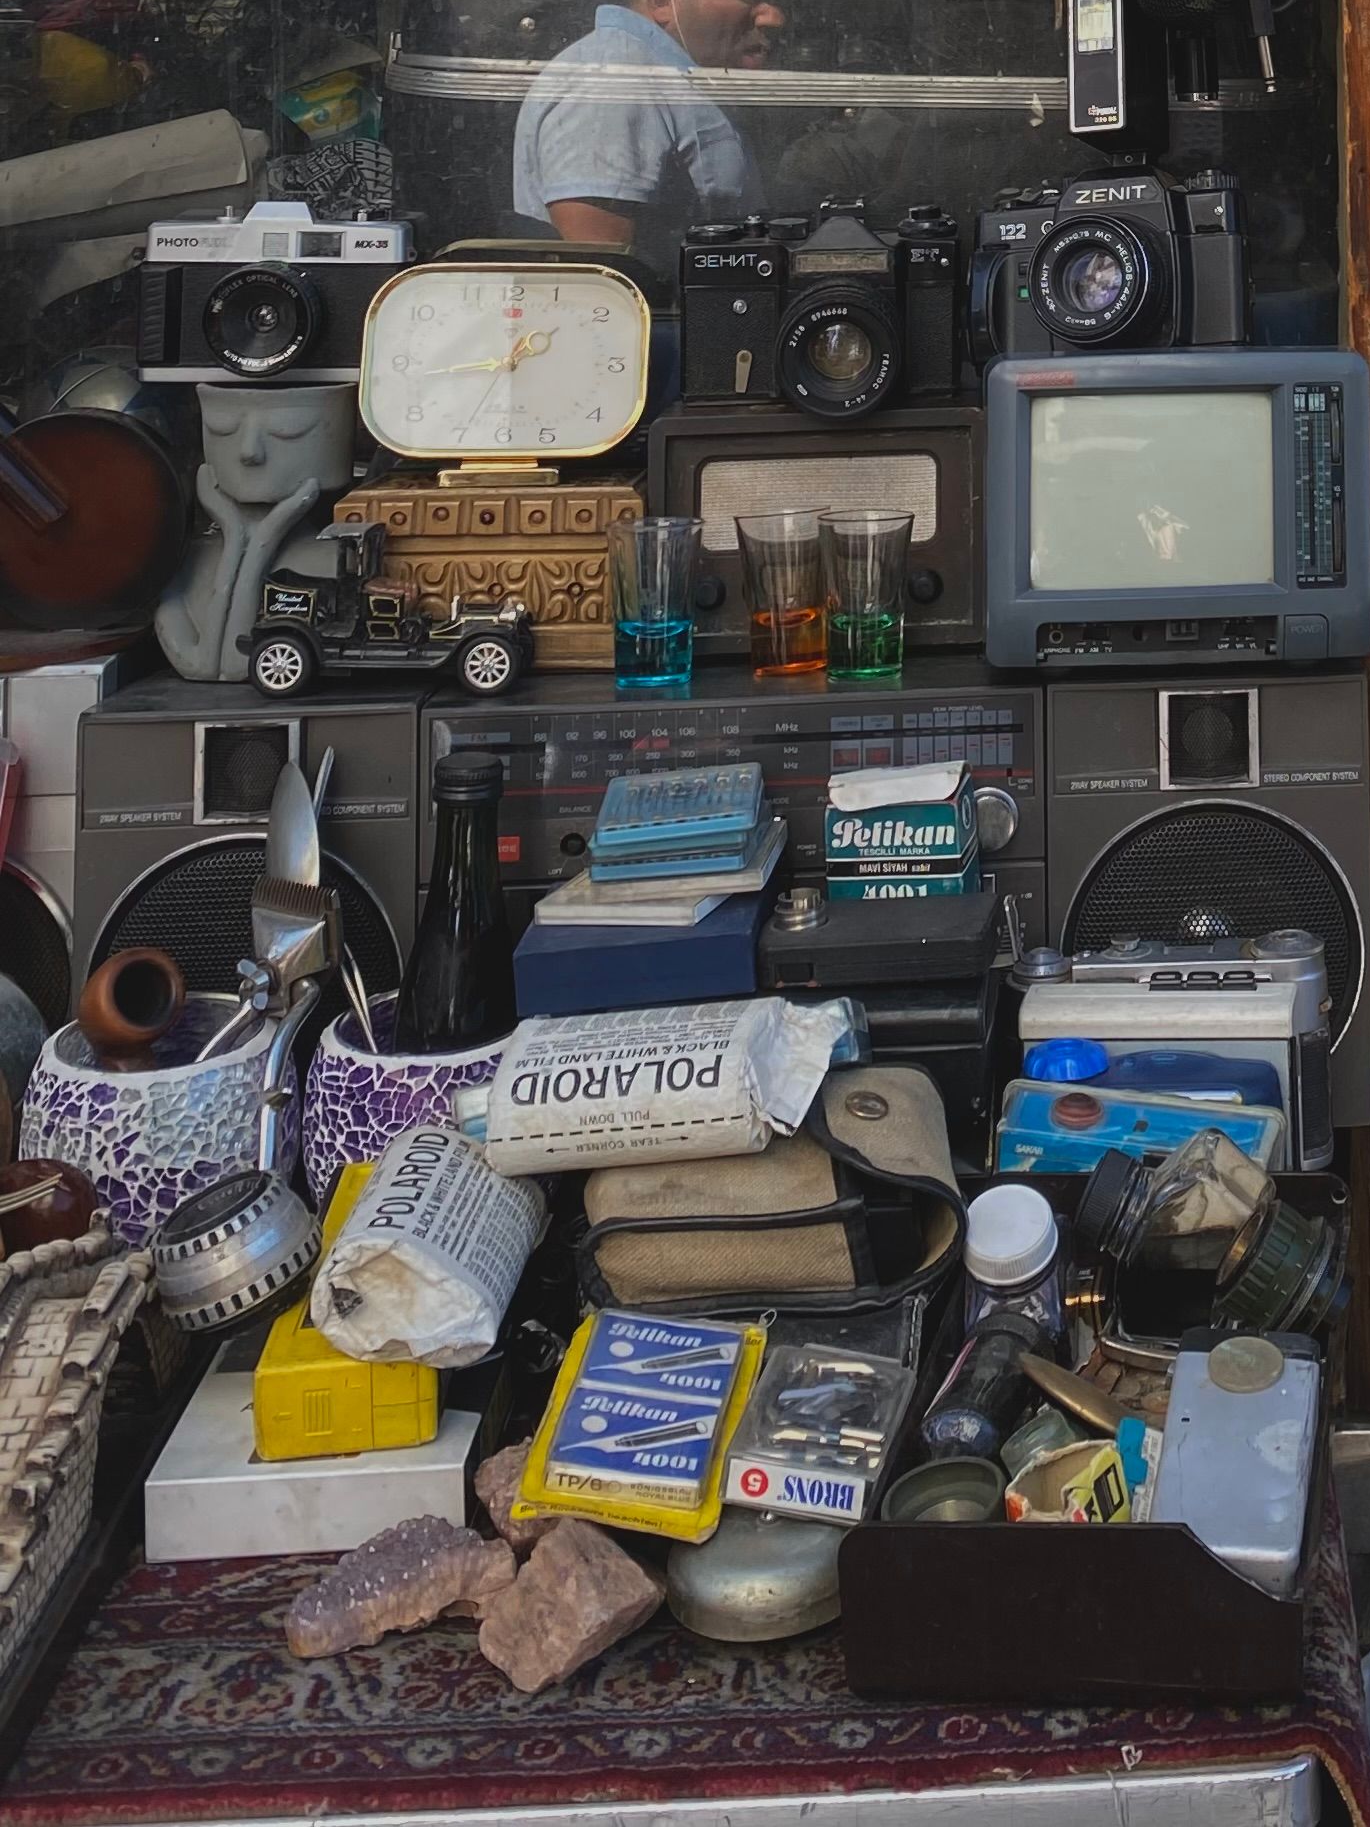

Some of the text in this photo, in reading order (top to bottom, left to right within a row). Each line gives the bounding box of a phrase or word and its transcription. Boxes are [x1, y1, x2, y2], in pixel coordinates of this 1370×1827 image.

[1075, 184, 1148, 204] ZENIT
[999, 224, 1026, 240] 122
[1095, 230, 1112, 241] MC
[354, 240, 389, 249] MX-35
[694, 253, 758, 268] ЗЕНИТ
[246, 275, 278, 285] OPTICAL
[282, 283, 298, 298] LENS
[502, 286, 525, 301] 12
[552, 285, 560, 302] 1
[592, 306, 610, 323] 2
[392, 353, 409, 372] 9
[607, 356, 625, 373] 3
[405, 405, 425, 422] 8
[585, 406, 603, 423] 4
[452, 427, 469, 443] 7
[494, 427, 512, 443] 6
[538, 427, 556, 444] 5
[534, 732, 548, 742] 88
[566, 730, 579, 741] 92
[593, 729, 608, 740] 96
[619, 729, 636, 739] 100
[651, 727, 669, 738] 104
[721, 724, 740, 735] 108
[775, 722, 799, 734] MHz
[783, 746, 799, 755] kHz
[783, 760, 799, 770] kHz
[1090, 779, 1120, 789] SPEAKER
[1121, 778, 1148, 788] SYSTEM
[1263, 771, 1359, 783] STEREO COMPONENT SYSTEM
[120, 813, 152, 822] SPEAKER
[153, 811, 182, 822] SYSTEM
[332, 804, 375, 815] COMPONENT
[376, 802, 406, 813] SYSTEM
[559, 805, 592, 814] BALANCE
[831, 818, 956, 848] Pelikan
[900, 847, 930, 855] MARKA
[605, 1046, 658, 1061] WHITE
[662, 1045, 675, 1054] &
[676, 1039, 730, 1053] BLACK
[514, 1056, 556, 1069] FILM
[557, 1050, 603, 1064] LAND
[511, 1054, 723, 1106] POLAROID
[579, 1110, 650, 1125] PULL DOWN
[452, 1140, 472, 1160] FILM
[576, 1136, 662, 1153] TEAR CORNER
[445, 1154, 463, 1186] LAND
[368, 1132, 450, 1230] POLAROID
[432, 1175, 452, 1204] WHITE
[412, 1212, 435, 1239] BLACK
[608, 1322, 703, 1348] Pelikan
[659, 1372, 722, 1391] 4001
[580, 1395, 679, 1422] Pelikan
[632, 1451, 698, 1471] 4001
[556, 1473, 601, 1492] TP/6
[745, 1475, 761, 1492] 5
[783, 1474, 854, 1512] BRONS
